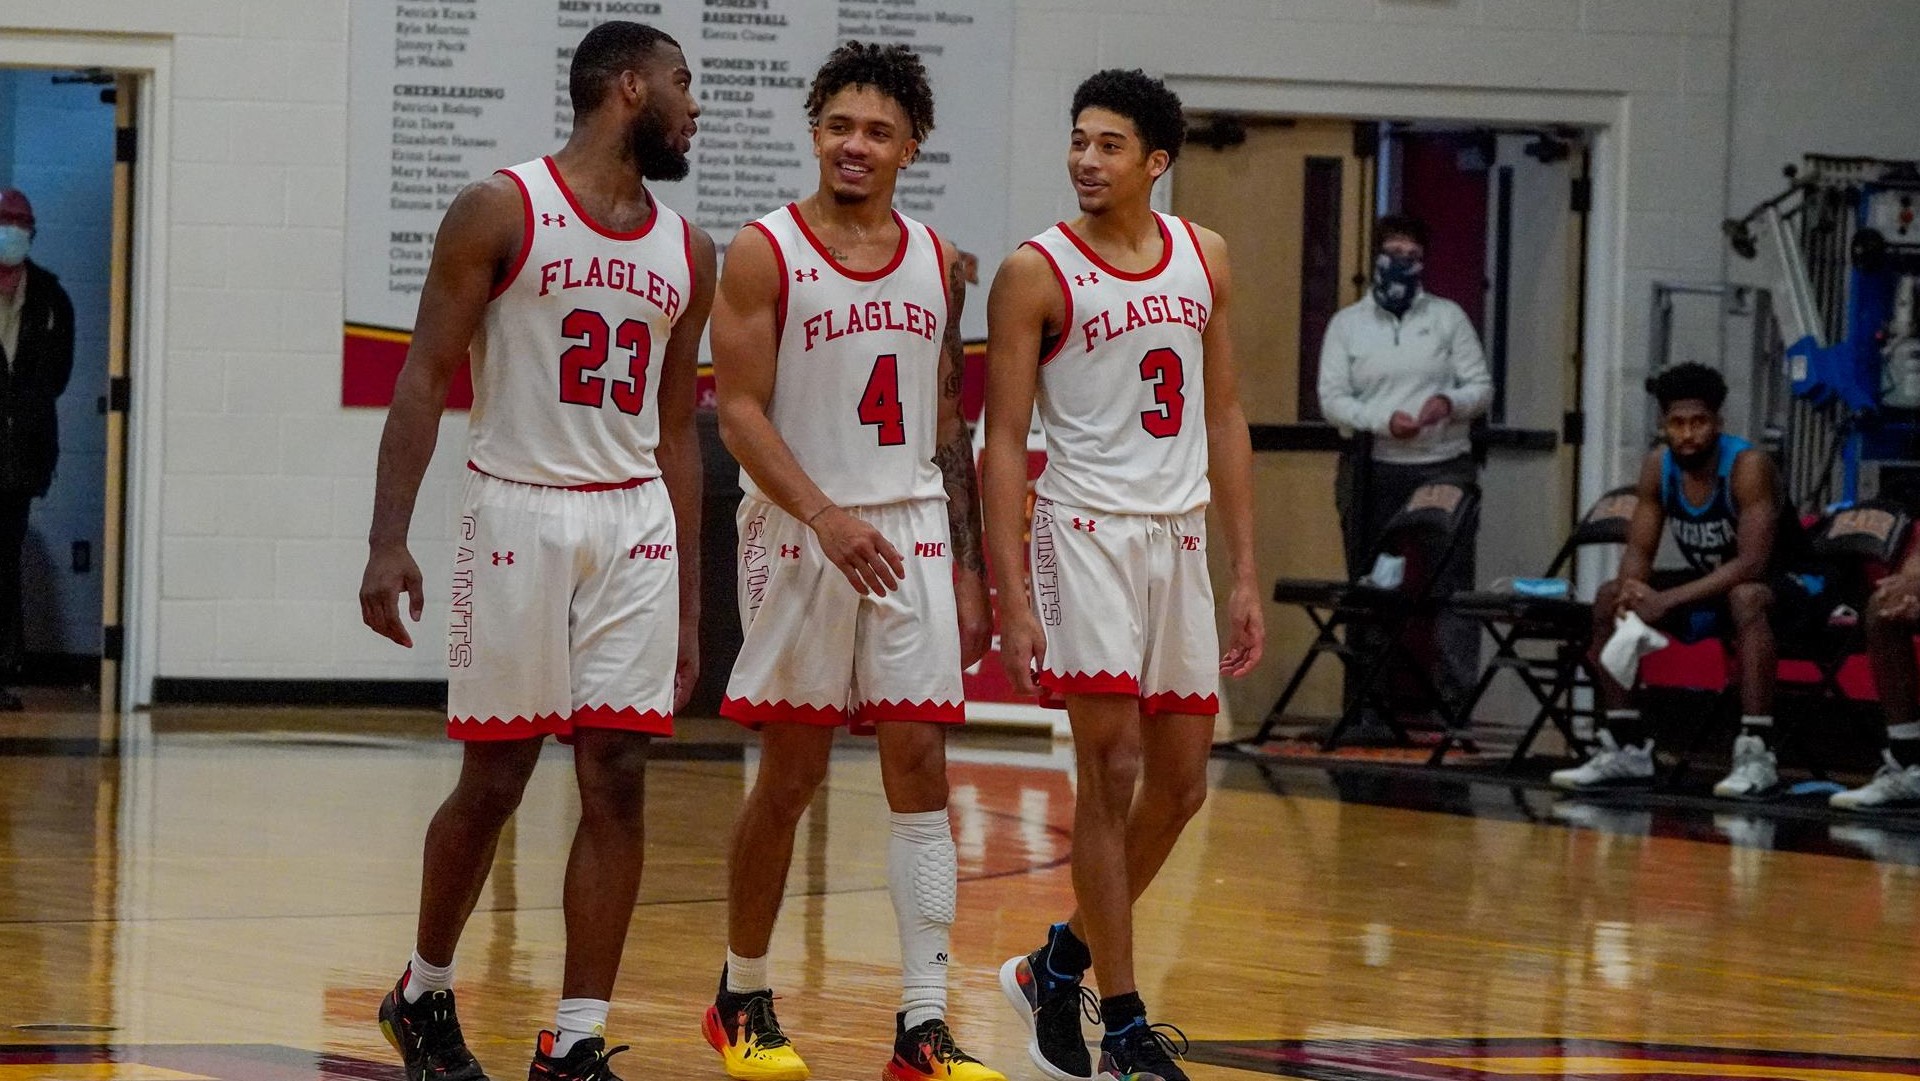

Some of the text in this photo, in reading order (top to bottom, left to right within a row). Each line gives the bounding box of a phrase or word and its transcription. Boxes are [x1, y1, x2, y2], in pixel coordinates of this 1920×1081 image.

[605, 3, 662, 14] SOCCER
[702, 11, 788, 26] BASKETBALL
[701, 57, 767, 71] WOMEN'S
[701, 73, 806, 88] INDOOR TRACK
[393, 84, 505, 99] CHEERLEADING
[713, 89, 755, 102] FIELD
[539, 257, 680, 322] FLAGLER
[803, 301, 937, 351] FLAGLER
[1082, 295, 1208, 353] FLAGLER
[560, 308, 651, 416] 23
[857, 353, 906, 446] 4
[1139, 347, 1185, 439] 3
[629, 544, 672, 560] PBC
[1036, 498, 1062, 626] AINTS
